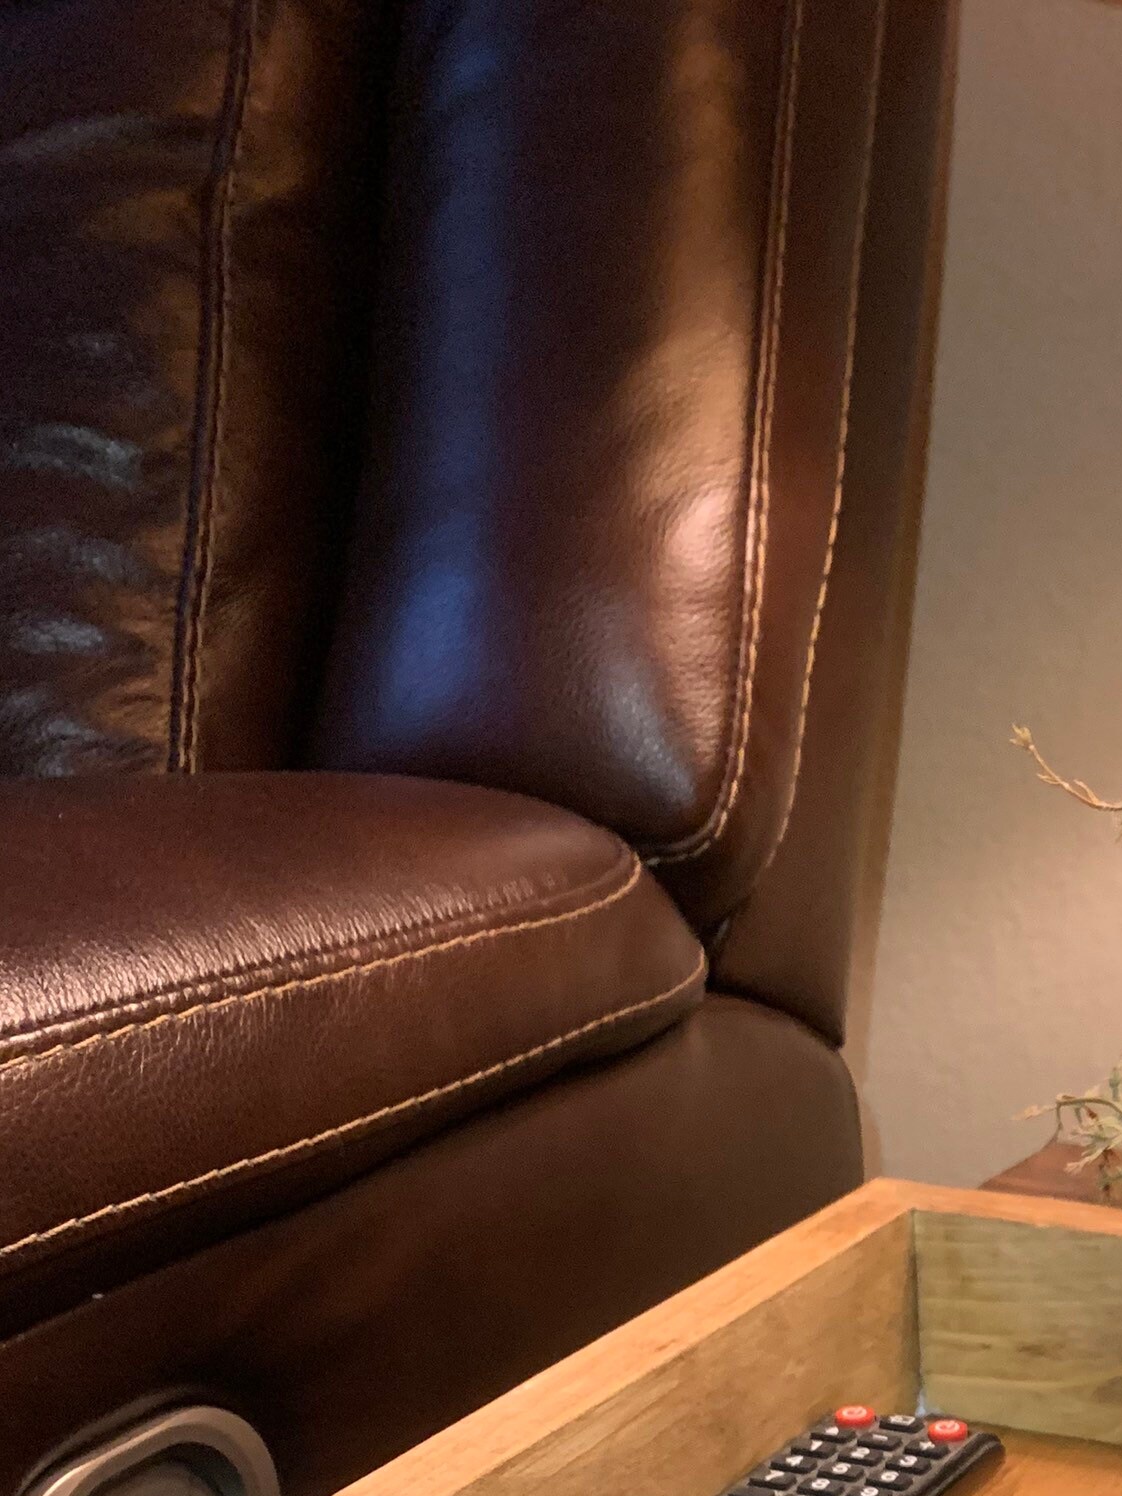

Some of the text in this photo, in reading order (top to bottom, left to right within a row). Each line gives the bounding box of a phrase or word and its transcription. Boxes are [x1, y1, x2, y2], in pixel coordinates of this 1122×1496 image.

[850, 1447, 870, 1459] 2
[785, 1455, 804, 1467] 4
[898, 1455, 918, 1467] 3
[832, 1462, 851, 1475] 5
[764, 1469, 785, 1482] 7
[880, 1470, 900, 1483] 6
[811, 1478, 831, 1490] 8
